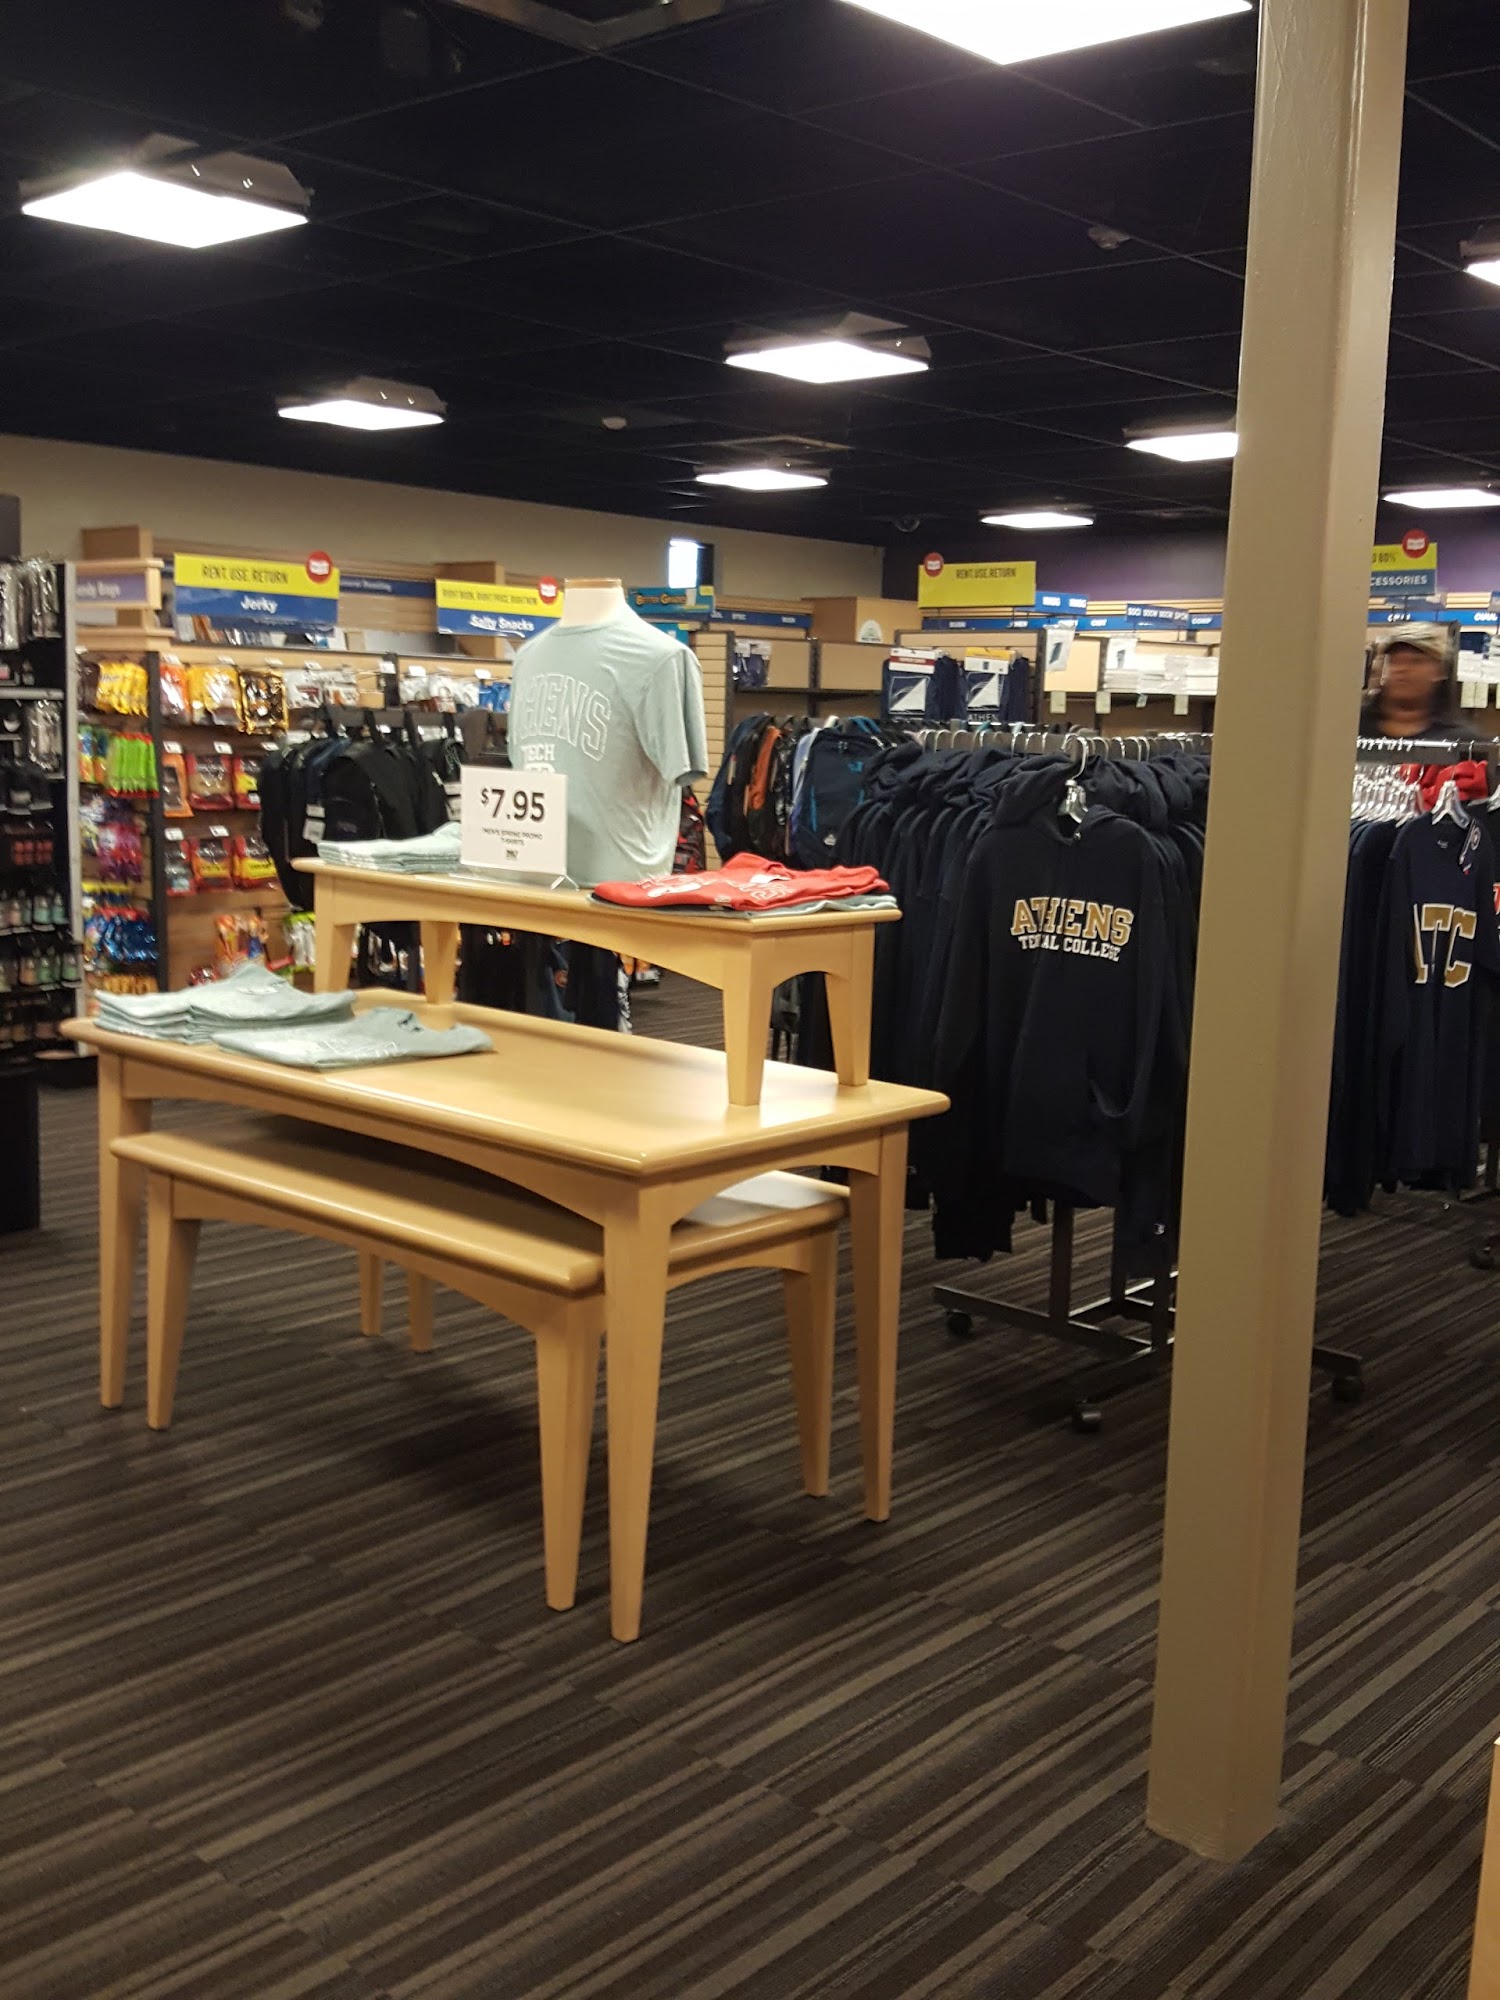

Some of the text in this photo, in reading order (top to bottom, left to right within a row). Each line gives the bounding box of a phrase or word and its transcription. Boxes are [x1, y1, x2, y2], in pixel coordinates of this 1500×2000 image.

[1370, 575, 1428, 587] CESSORIES
[239, 595, 278, 614] Jerky
[470, 614, 535, 632] Salty Snacks
[481, 787, 545, 823] $7.95
[1010, 896, 1135, 946] ATHENS
